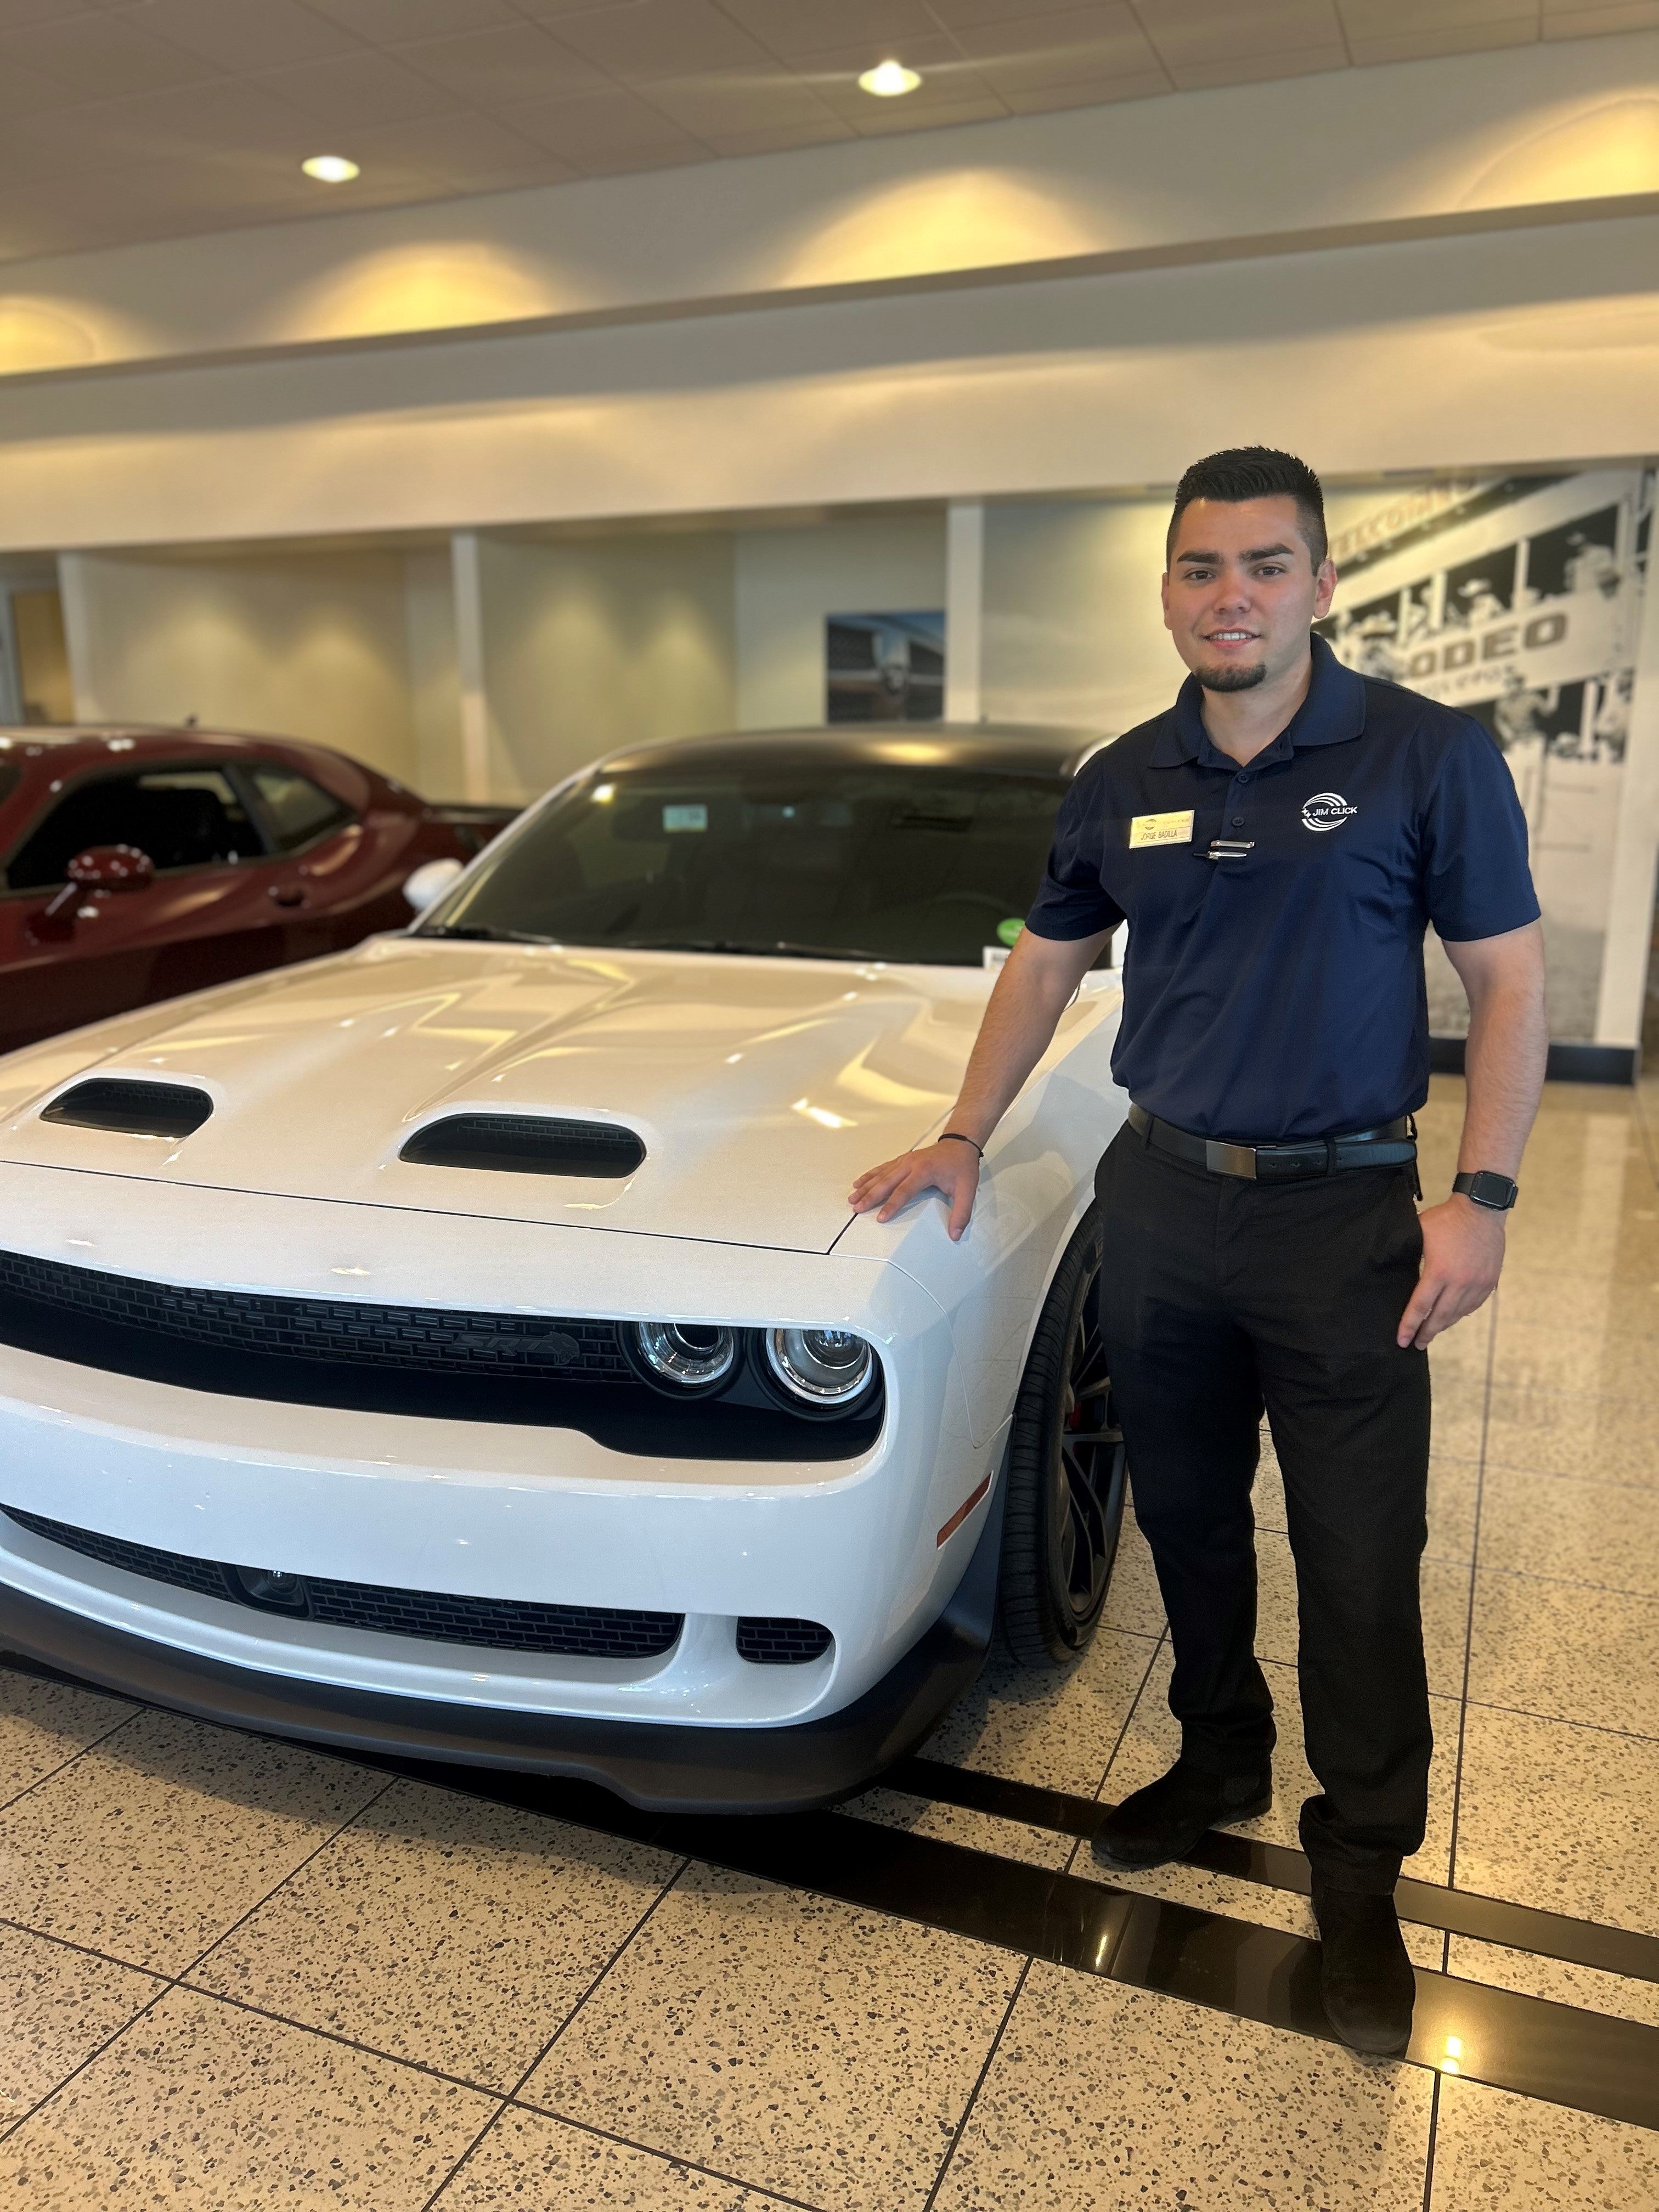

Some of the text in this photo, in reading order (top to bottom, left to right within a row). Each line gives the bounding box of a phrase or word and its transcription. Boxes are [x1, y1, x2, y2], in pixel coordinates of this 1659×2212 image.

[1409, 613, 1567, 679] ODEO
[1312, 806, 1358, 816] JIM CLICK
[1141, 830, 1177, 840] JORGE BADILLA
[454, 1334, 554, 1356] SRT
